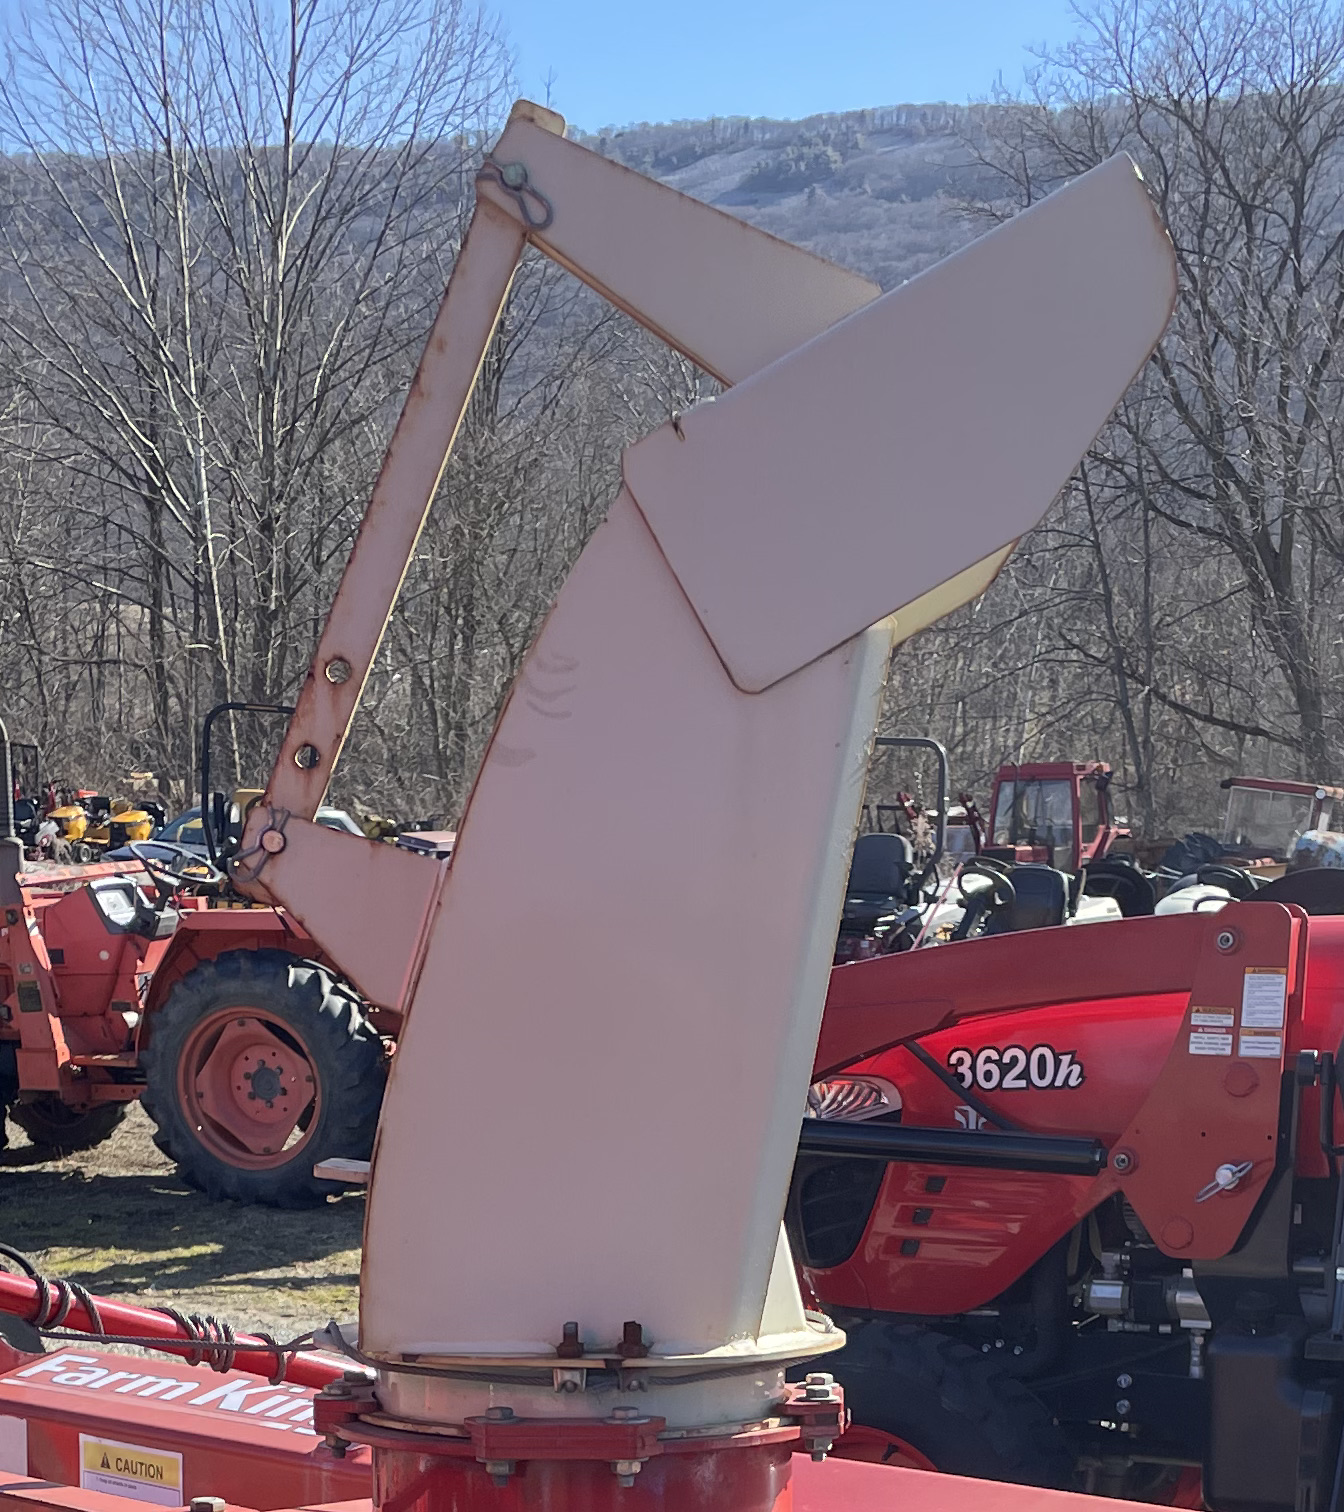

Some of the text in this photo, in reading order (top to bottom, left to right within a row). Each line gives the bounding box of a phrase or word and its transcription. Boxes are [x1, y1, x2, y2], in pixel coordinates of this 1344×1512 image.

[15, 1353, 317, 1436] Farm Kin
[115, 1457, 164, 1480] CAUTION
